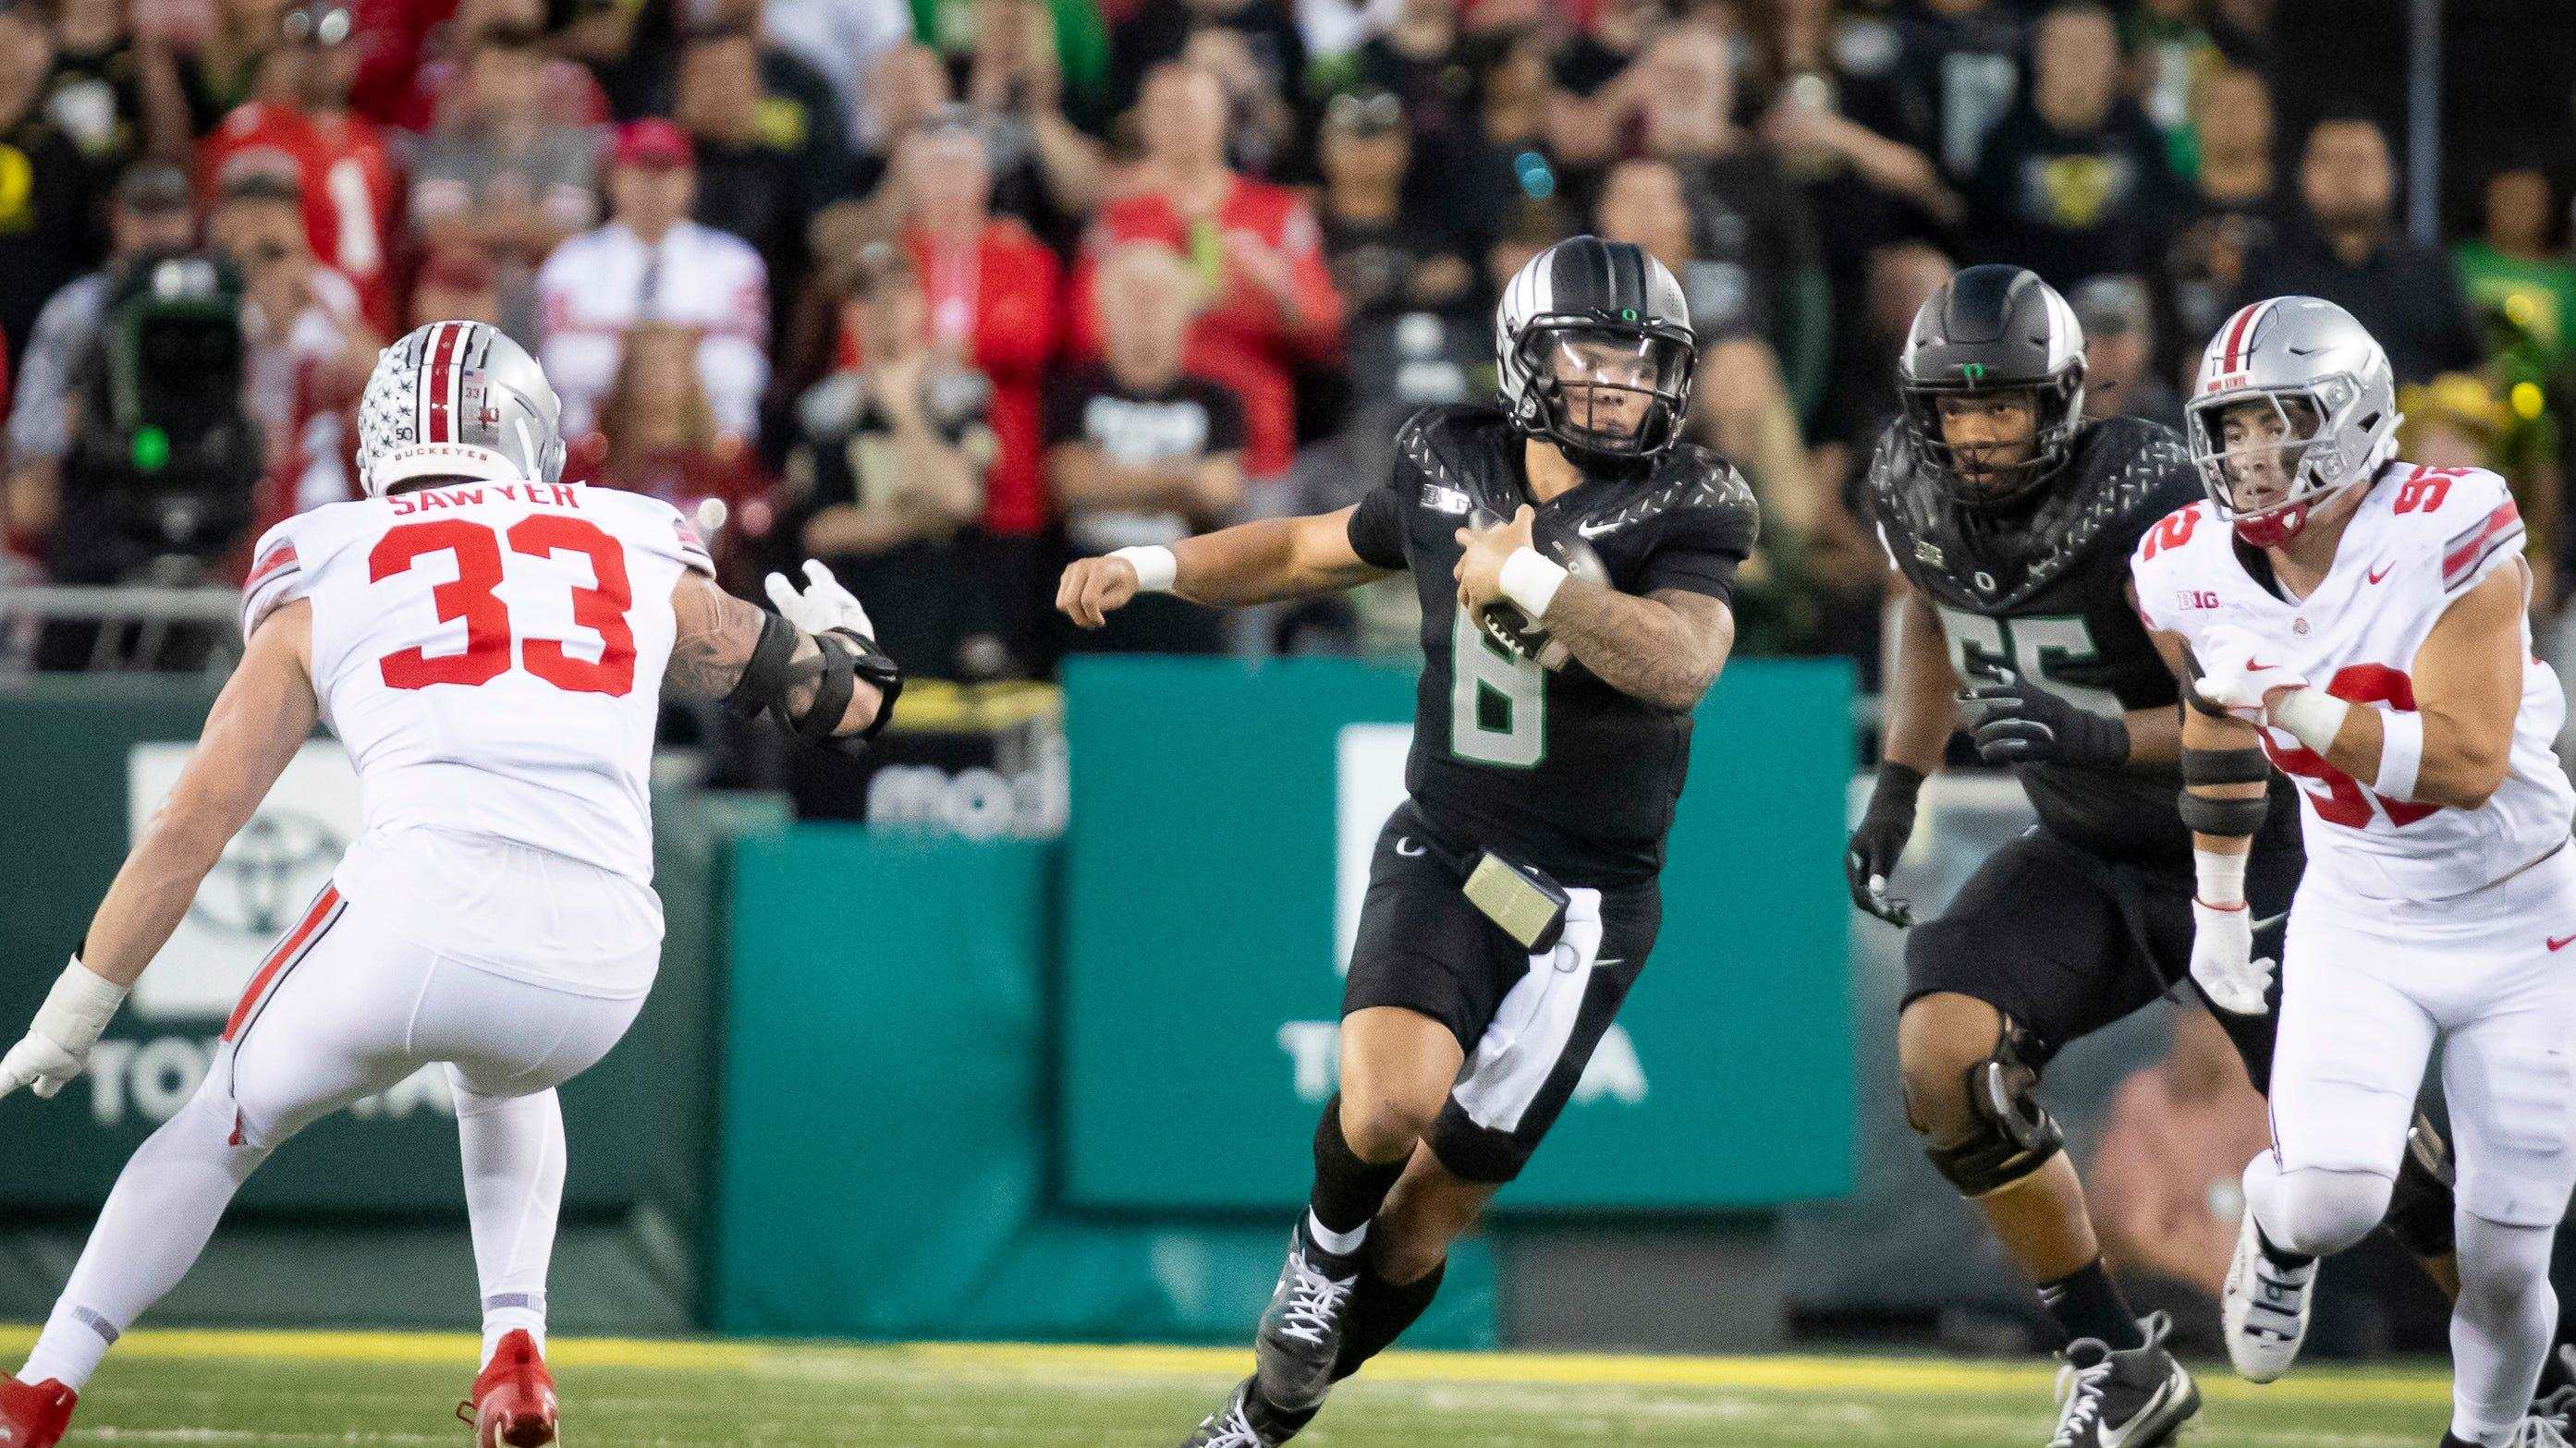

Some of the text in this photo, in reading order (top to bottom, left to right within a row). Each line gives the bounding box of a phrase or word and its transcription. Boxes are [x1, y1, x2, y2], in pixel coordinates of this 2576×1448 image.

[394, 447, 489, 462] BUCKEYES
[386, 482, 580, 517] SAWYER
[368, 513, 638, 699] 33
